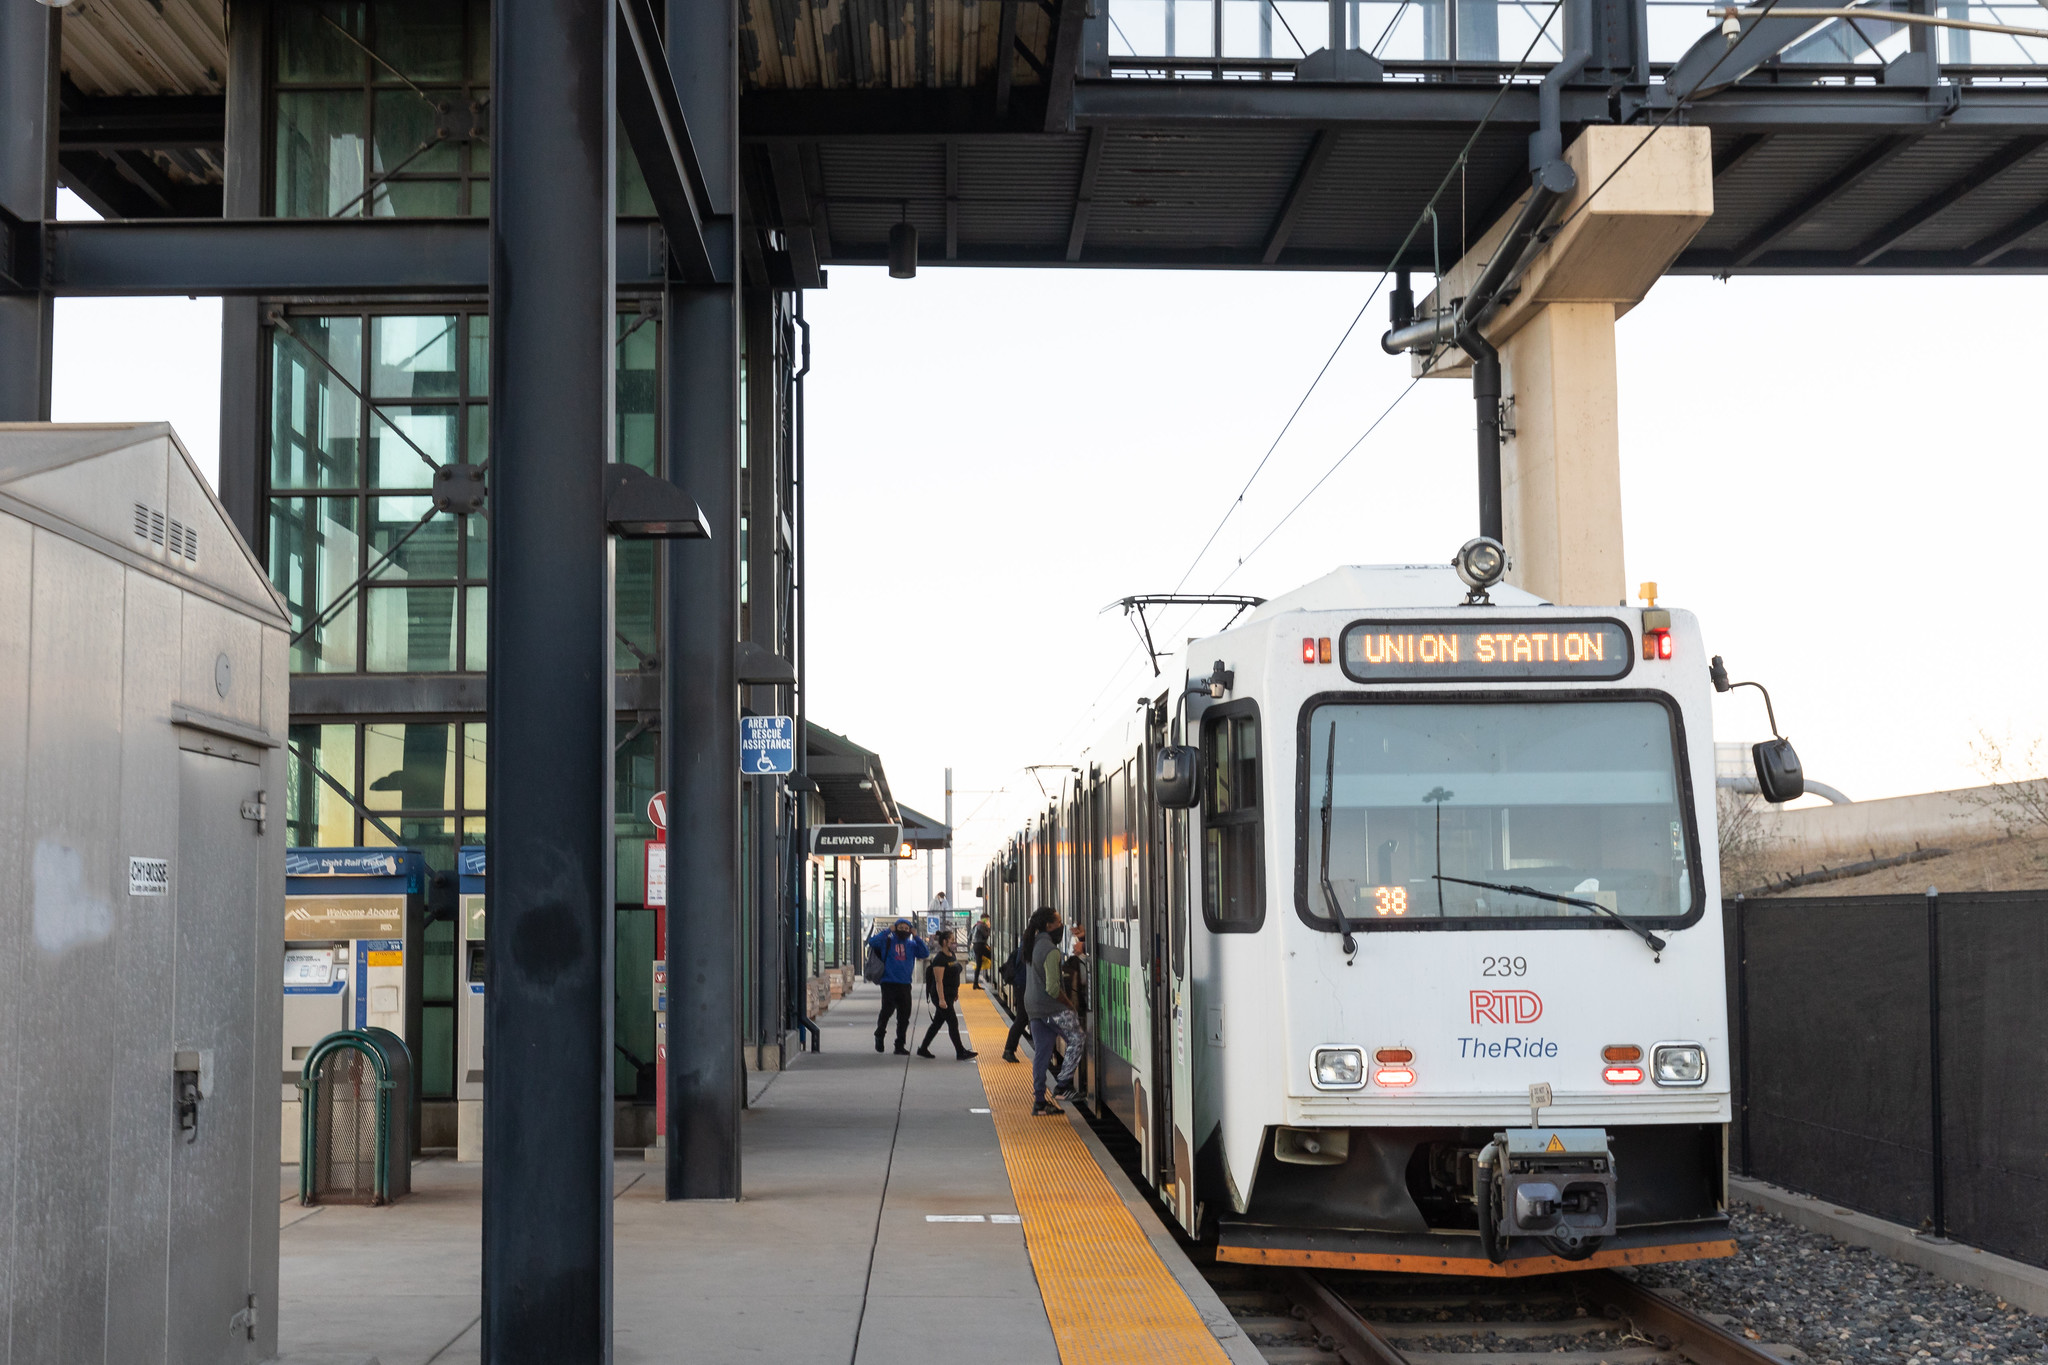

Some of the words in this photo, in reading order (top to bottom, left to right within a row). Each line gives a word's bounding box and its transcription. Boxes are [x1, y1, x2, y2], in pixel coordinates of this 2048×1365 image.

[1365, 633, 1458, 663] UNION
[1476, 632, 1603, 662] STATION
[748, 719, 769, 729] AREA
[775, 719, 786, 729] OF
[751, 729, 782, 739] RESCUE
[743, 739, 791, 750] ASSISTANCE
[820, 836, 875, 845] ELEVATORS
[321, 859, 342, 867] Light
[344, 859, 361, 867] Rail
[1375, 886, 1407, 915] 38
[326, 907, 365, 917] Welcome
[366, 907, 399, 917] Aboard
[1482, 956, 1528, 977] 239
[1469, 990, 1543, 1024] RTD
[1457, 1037, 1558, 1058] TheRide
